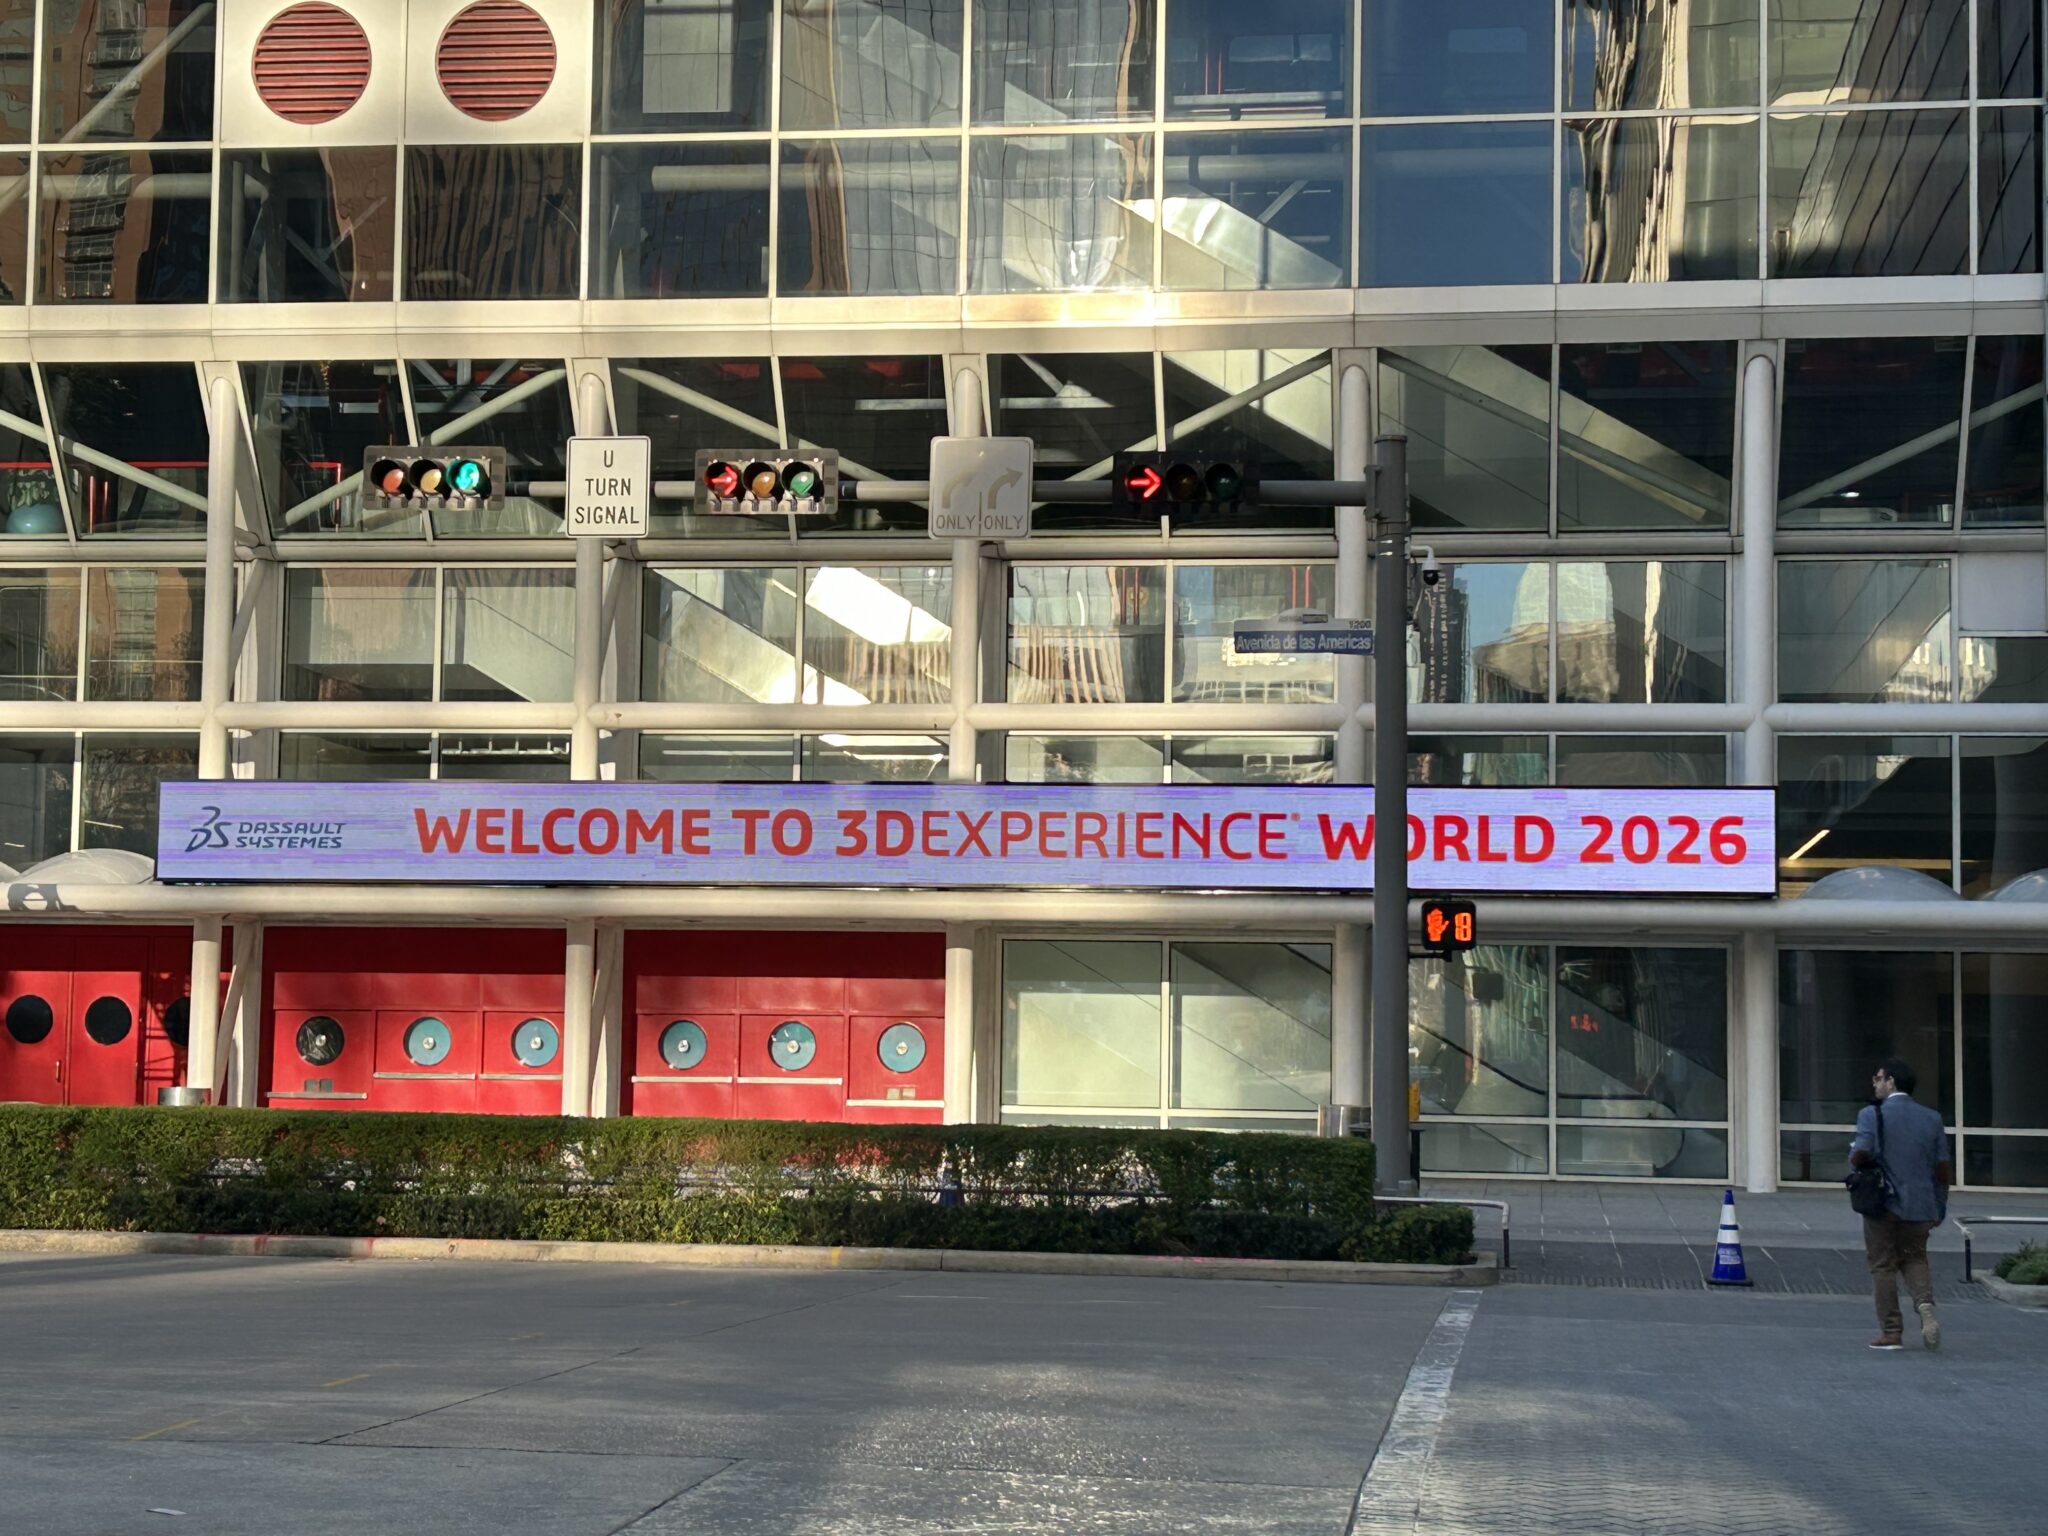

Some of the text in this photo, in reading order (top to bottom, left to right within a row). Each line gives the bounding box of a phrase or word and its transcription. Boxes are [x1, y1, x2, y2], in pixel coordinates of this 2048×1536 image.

[603, 450, 614, 468] U
[585, 478, 631, 496] TURN
[574, 506, 640, 524] SIGNAL
[936, 514, 1024, 530] ONLY ONLY
[1236, 633, 1372, 650] Avenida de las Americas
[238, 821, 347, 834] DASSAULT
[235, 836, 342, 849] SYSTEMES
[415, 808, 710, 855] WELCOME
[732, 810, 813, 856] TO
[1579, 815, 1748, 865] 2026
